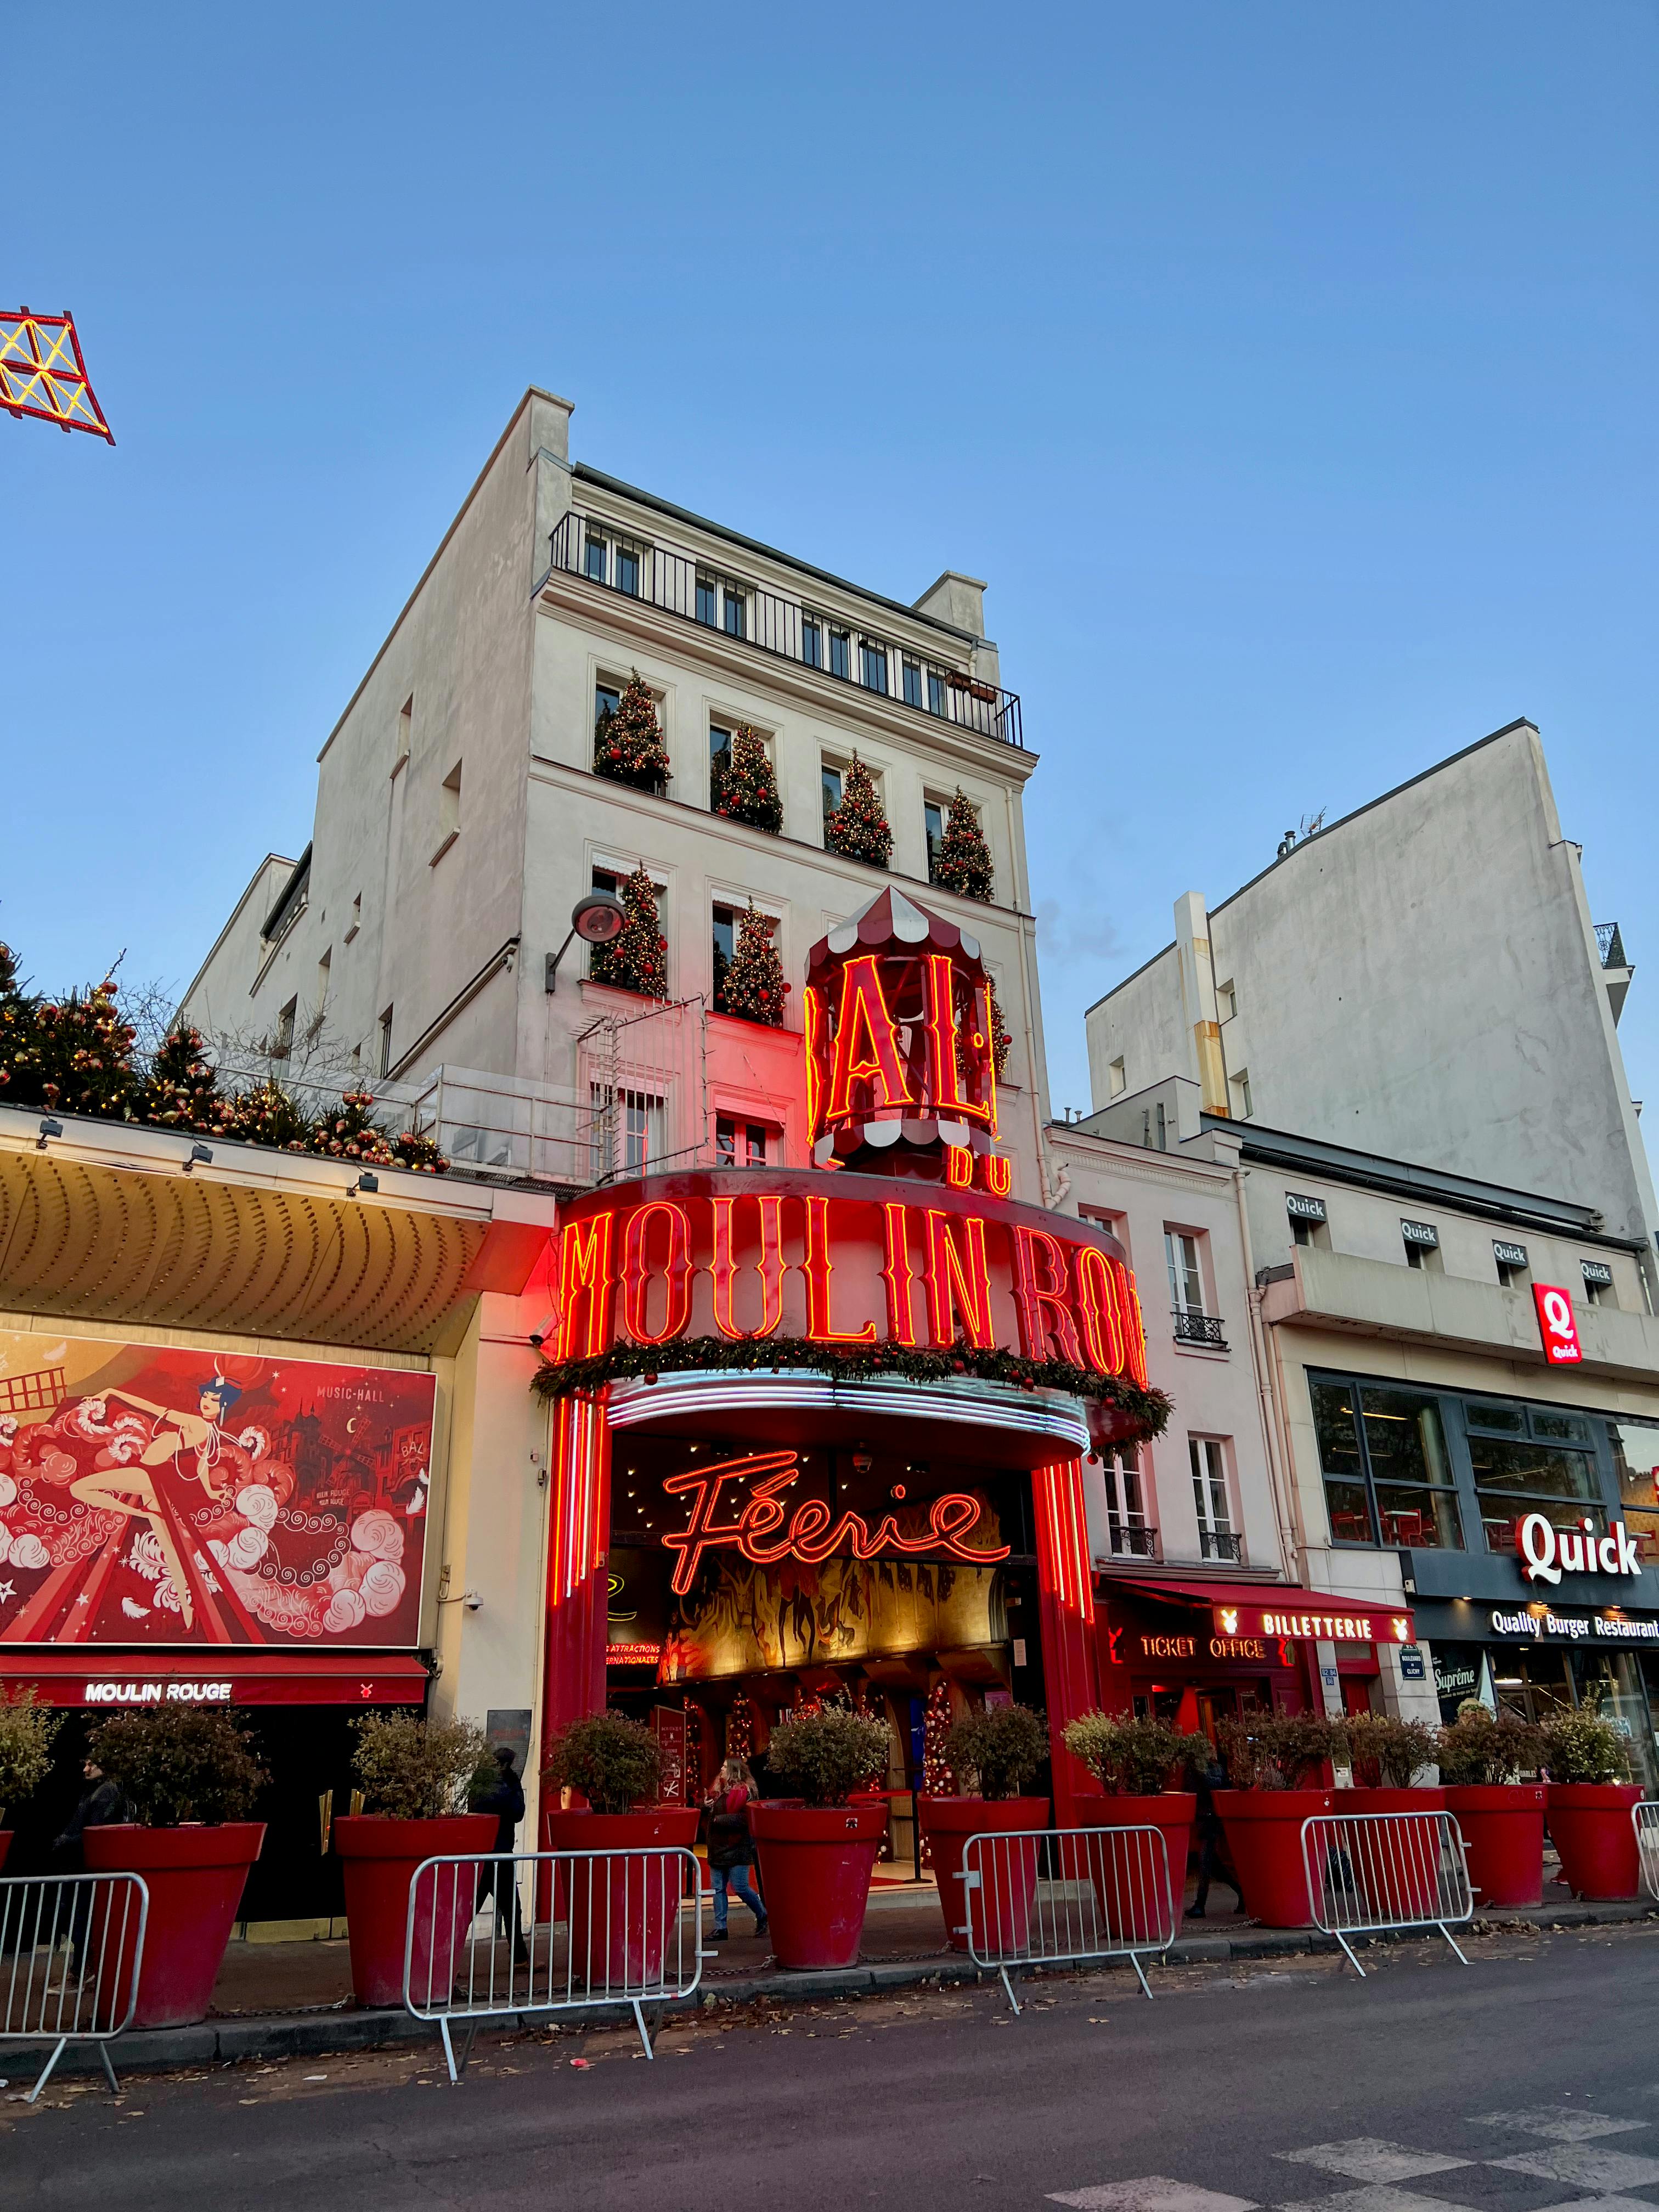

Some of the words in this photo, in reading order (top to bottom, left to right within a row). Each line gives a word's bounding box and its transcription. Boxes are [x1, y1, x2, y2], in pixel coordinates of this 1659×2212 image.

[947, 1144, 1012, 1197] DU
[1286, 1195, 1325, 1217] Quick
[1401, 1222, 1437, 1242] Quick
[1493, 1243, 1526, 1262] Quick
[557, 1194, 996, 1364] MOULIN
[1580, 1262, 1611, 1280] Quick
[1544, 1291, 1574, 1340] Q
[1552, 1344, 1578, 1359] Quick
[317, 1386, 385, 1403] MUSIC-HALL
[401, 1441, 424, 1458] BAL
[662, 1449, 1011, 1595] Féerie
[1517, 1513, 1643, 1585] Quick
[1262, 1613, 1372, 1638] BILLETTERIE
[1492, 1610, 1541, 1638] Quality
[1546, 1612, 1590, 1639] Burger
[1594, 1616, 1659, 1638] Restaurant
[610, 1645, 660, 1654] ATTRACTIONS
[1140, 1635, 1198, 1657] TICKET
[1210, 1638, 1267, 1658] OFFICE
[1435, 1667, 1475, 1692] Suprême
[84, 1683, 162, 1702] MOULIN
[166, 1683, 233, 1701] ROUGE
